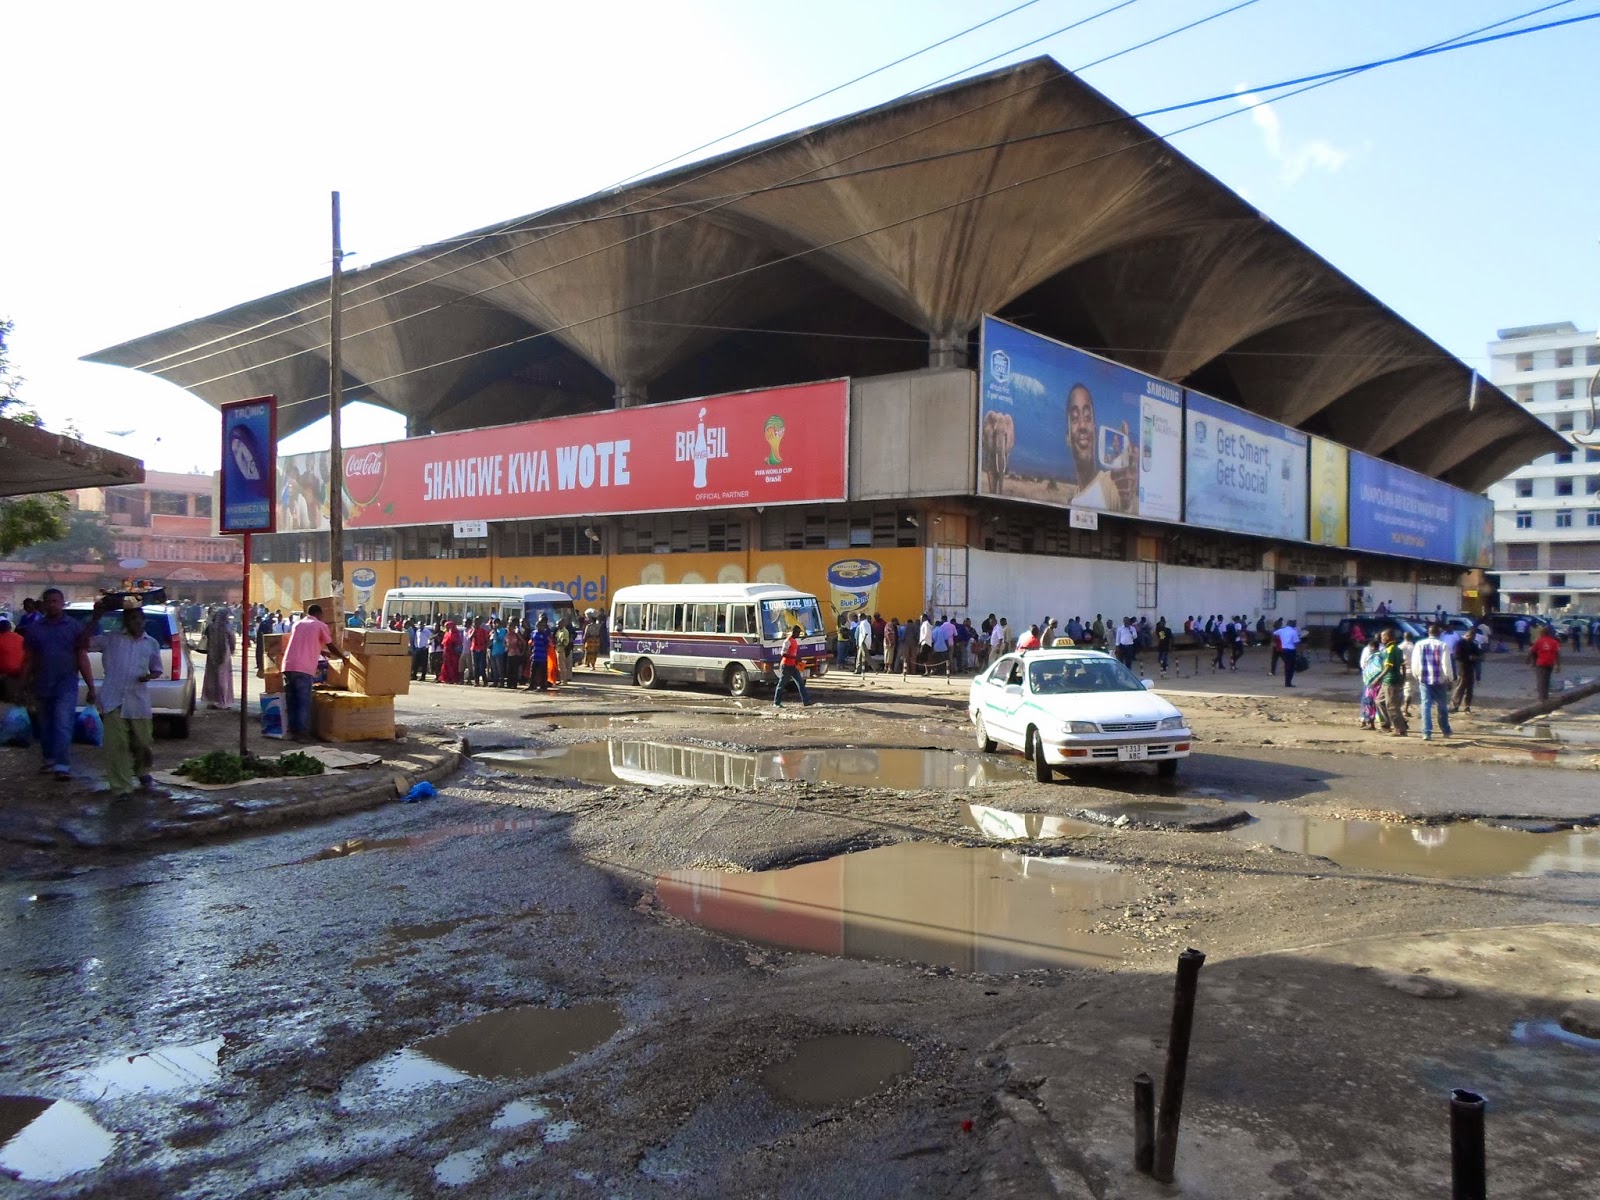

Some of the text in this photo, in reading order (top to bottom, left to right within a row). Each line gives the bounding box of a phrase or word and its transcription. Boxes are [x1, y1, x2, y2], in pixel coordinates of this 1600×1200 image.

[1147, 381, 1179, 404] SAMSUNG
[1217, 428, 1236, 457] Get
[1239, 435, 1271, 470] Smart,
[423, 440, 631, 501] SHANGWE KWA WOTE
[1217, 458, 1268, 494] Get Social
[695, 491, 749, 500] OFFICIAL PARTNER
[501, 575, 606, 601] kinde!
[854, 593, 869, 605] Band
